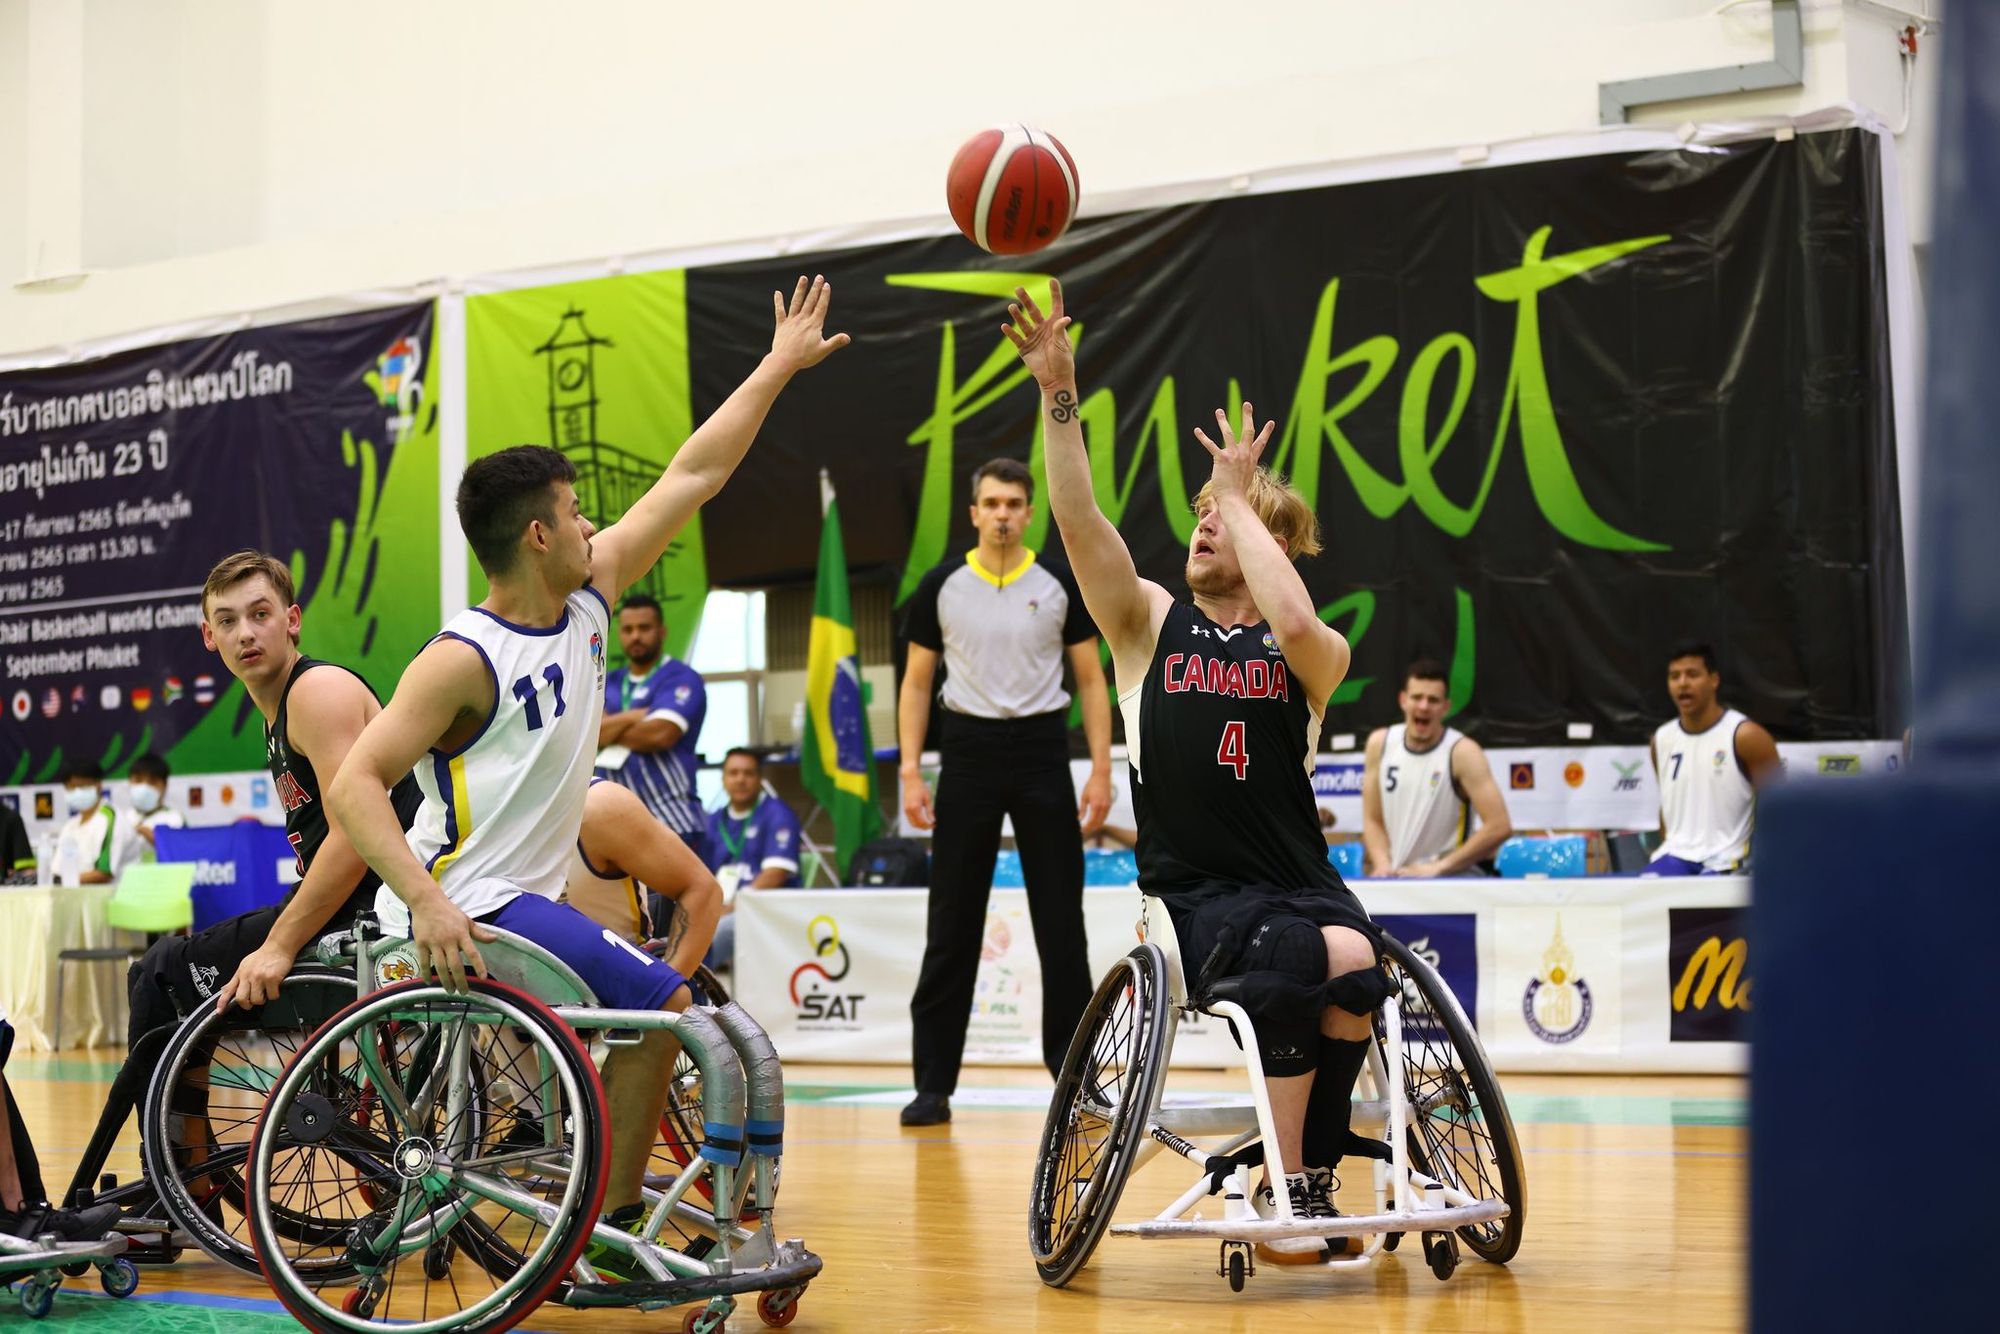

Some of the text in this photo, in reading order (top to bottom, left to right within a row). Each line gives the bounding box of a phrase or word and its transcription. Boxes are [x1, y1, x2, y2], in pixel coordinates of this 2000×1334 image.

[113, 442, 143, 477] 23
[148, 426, 168, 470] ปี
[78, 507, 113, 532] 2565
[31, 544, 65, 570] 2565
[100, 535, 138, 561] 13.30
[31, 575, 65, 600] 2565
[31, 610, 108, 643] Basketball
[109, 606, 154, 634] world
[6, 643, 141, 681] September Phuket
[1164, 652, 1289, 703] CANADA
[512, 663, 567, 732] 11
[1217, 721, 1249, 781] 4
[1671, 753, 1684, 780] 7
[1386, 766, 1399, 792] 5
[797, 994, 865, 1021] SAT
